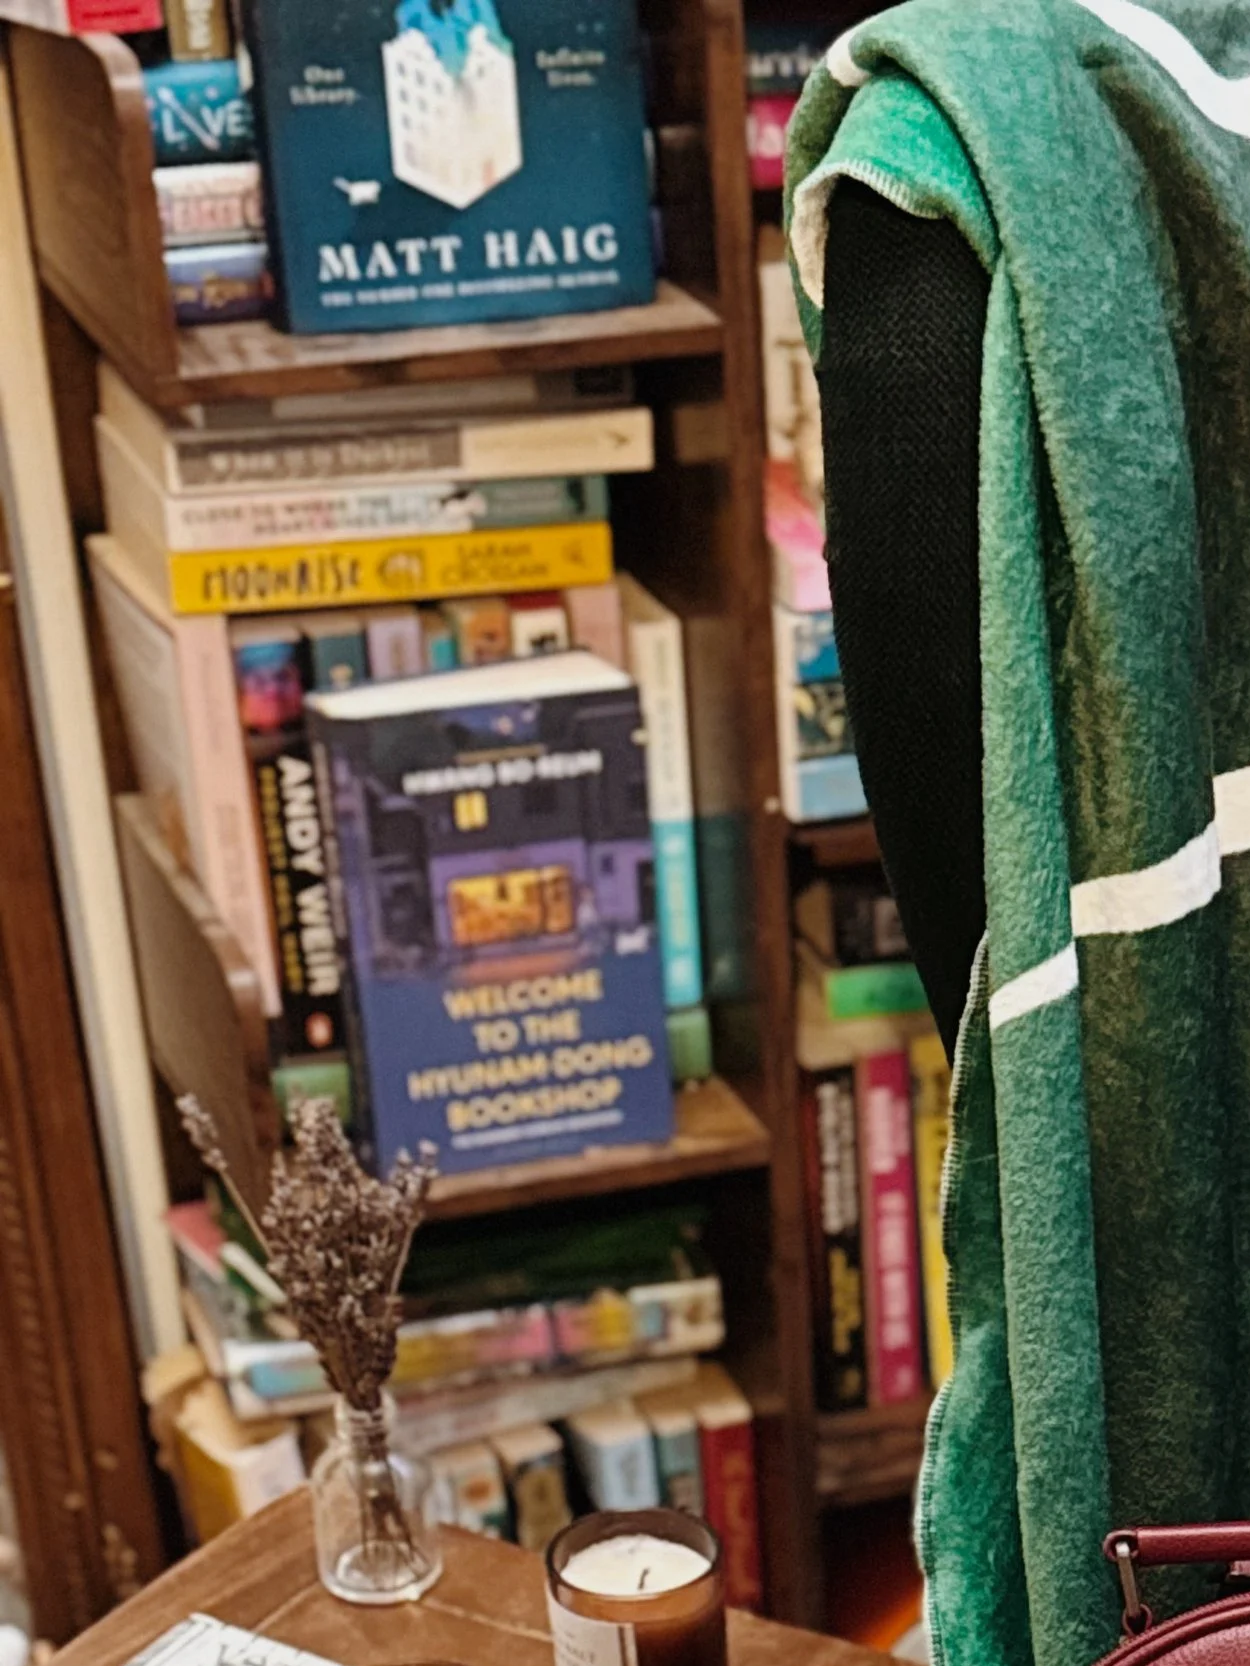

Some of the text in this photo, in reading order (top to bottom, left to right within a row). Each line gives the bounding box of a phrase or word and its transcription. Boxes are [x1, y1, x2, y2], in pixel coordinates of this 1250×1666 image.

[318, 222, 619, 283] MATT HAIG
[277, 754, 325, 875] ANDY
[296, 884, 341, 997] WEIR
[443, 968, 605, 1021] WELCOME
[472, 1008, 581, 1054] TO THE
[446, 1075, 624, 1133] BOOKSHOP
